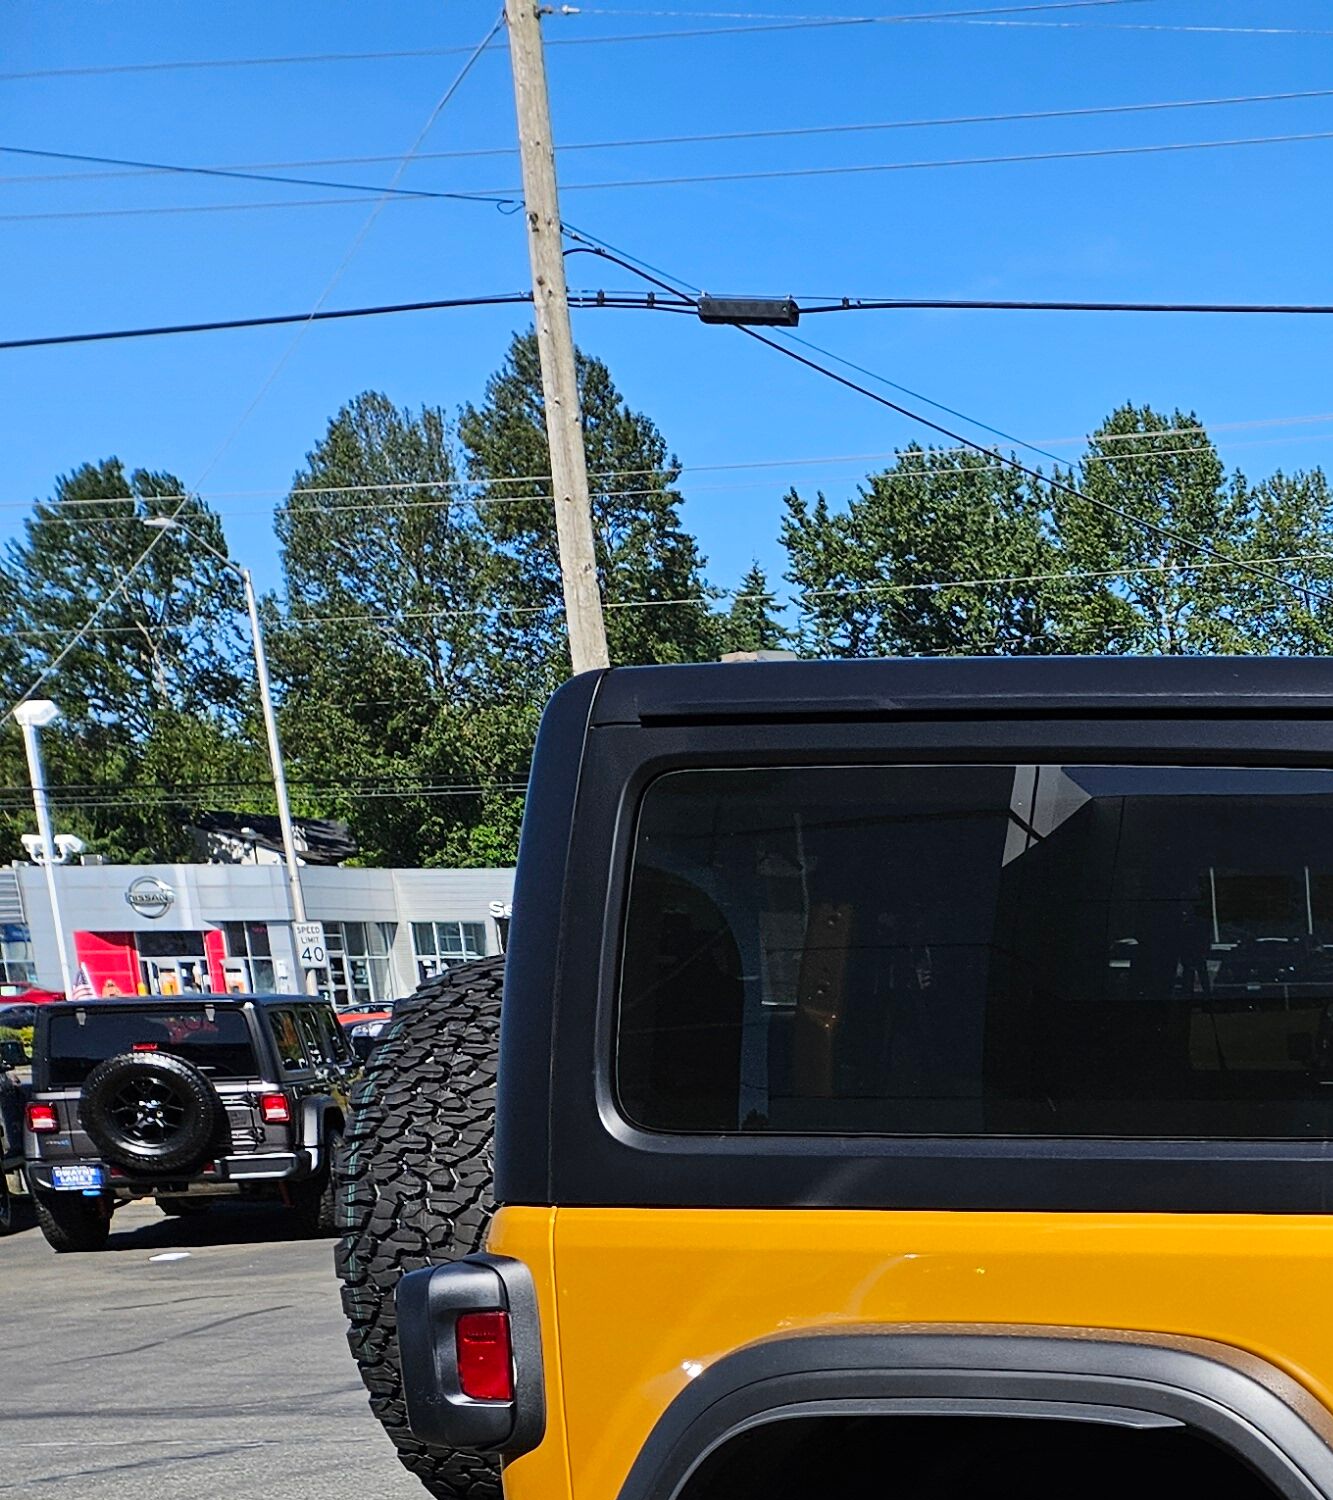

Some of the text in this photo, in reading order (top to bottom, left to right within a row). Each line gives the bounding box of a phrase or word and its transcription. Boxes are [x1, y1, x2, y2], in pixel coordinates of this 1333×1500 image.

[297, 926, 320, 934] SPEED
[301, 936, 319, 944] LIMIT
[301, 947, 324, 962] 40
